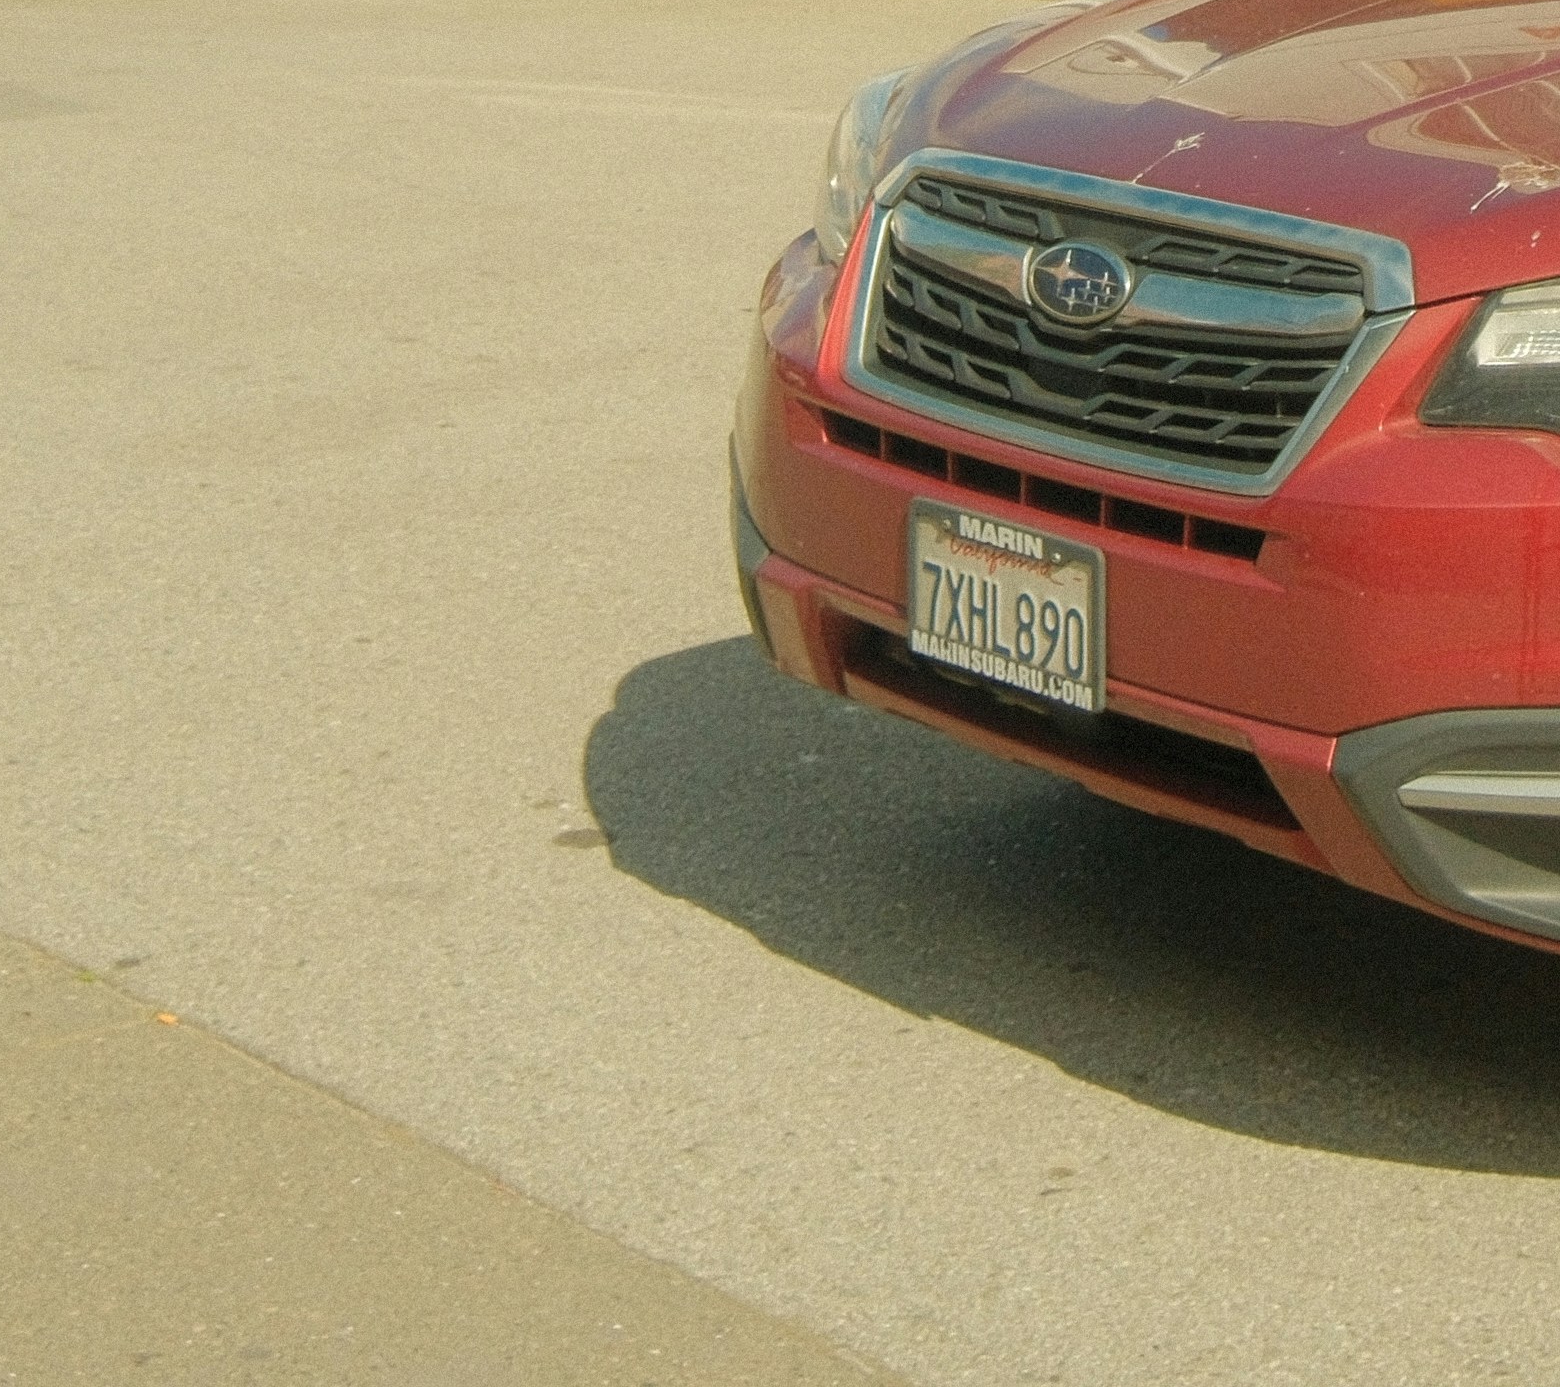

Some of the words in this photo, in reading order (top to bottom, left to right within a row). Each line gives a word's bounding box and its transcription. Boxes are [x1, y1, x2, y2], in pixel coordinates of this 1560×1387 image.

[959, 514, 1043, 559] MARIN
[923, 561, 1083, 680] 7XHL890
[912, 629, 1094, 712] MARINSUBARU.COM
